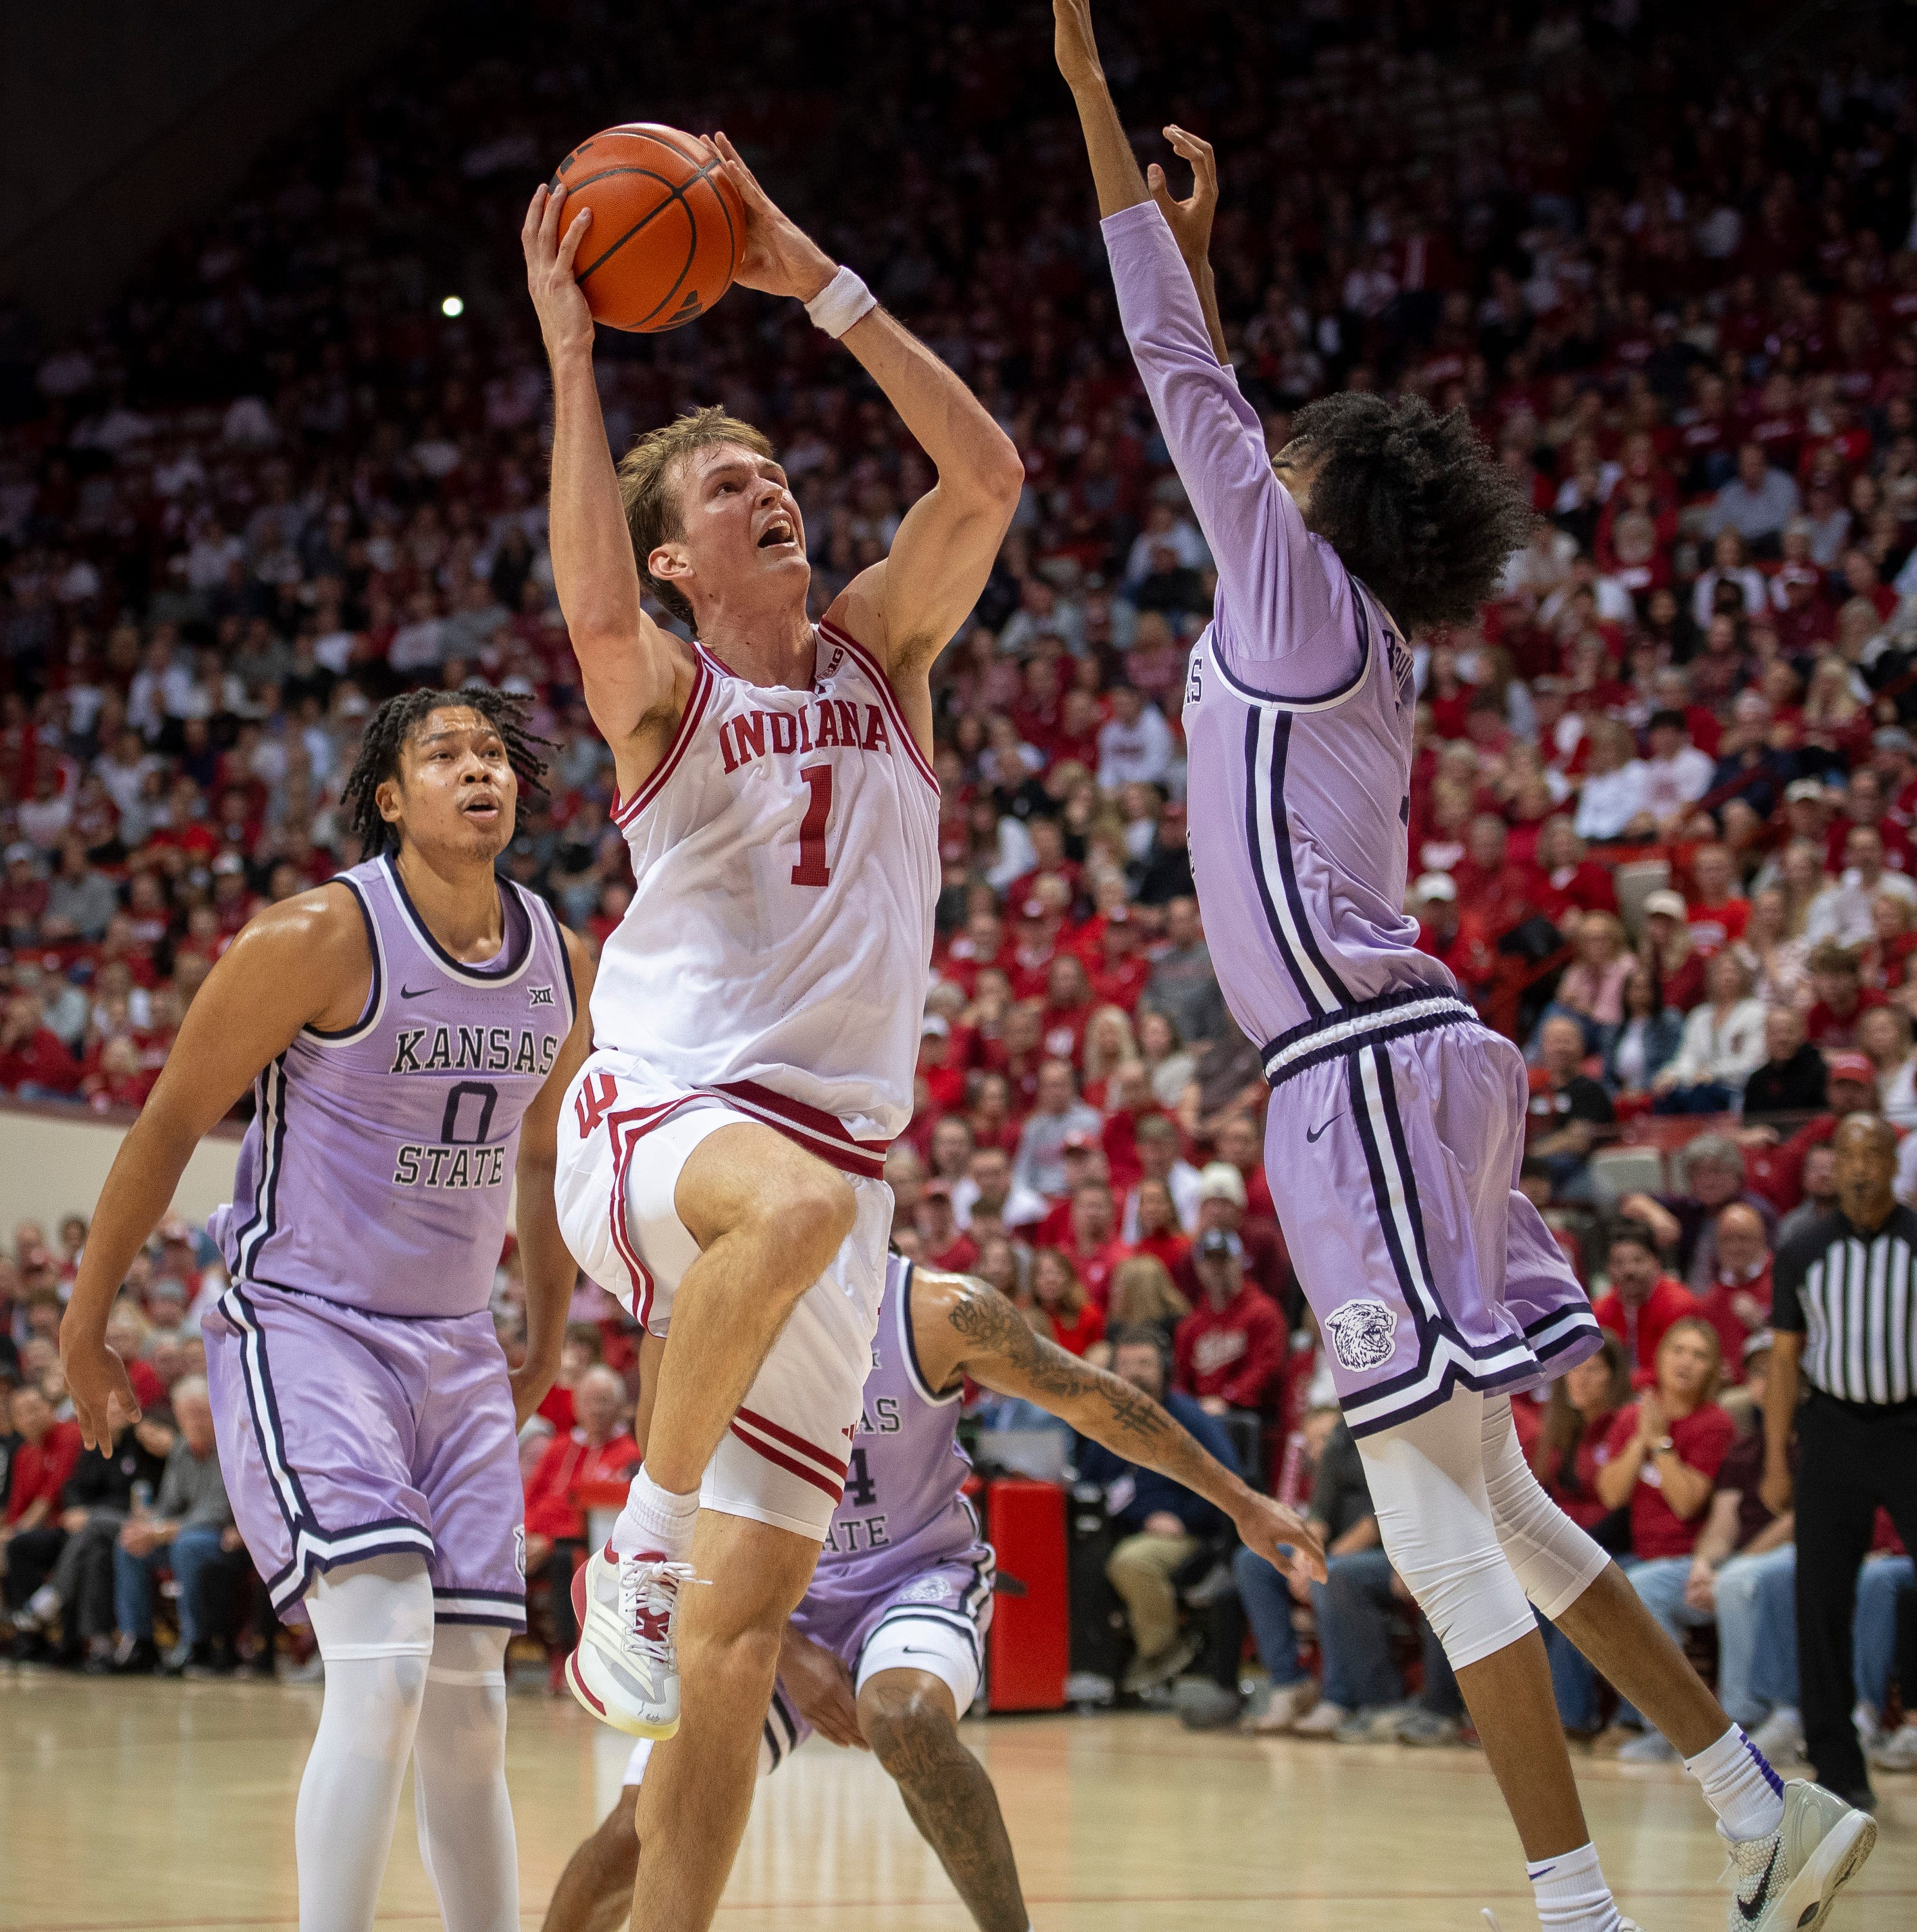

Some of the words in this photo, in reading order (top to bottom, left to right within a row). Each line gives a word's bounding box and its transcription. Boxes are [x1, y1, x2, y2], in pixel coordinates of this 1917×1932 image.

[719, 699, 892, 775] INDIANA
[791, 764, 833, 887] 1
[390, 1025, 558, 1077] KANSAS
[440, 1081, 498, 1144] 0
[392, 1144, 505, 1189] STATE
[844, 1448, 877, 1508] 4
